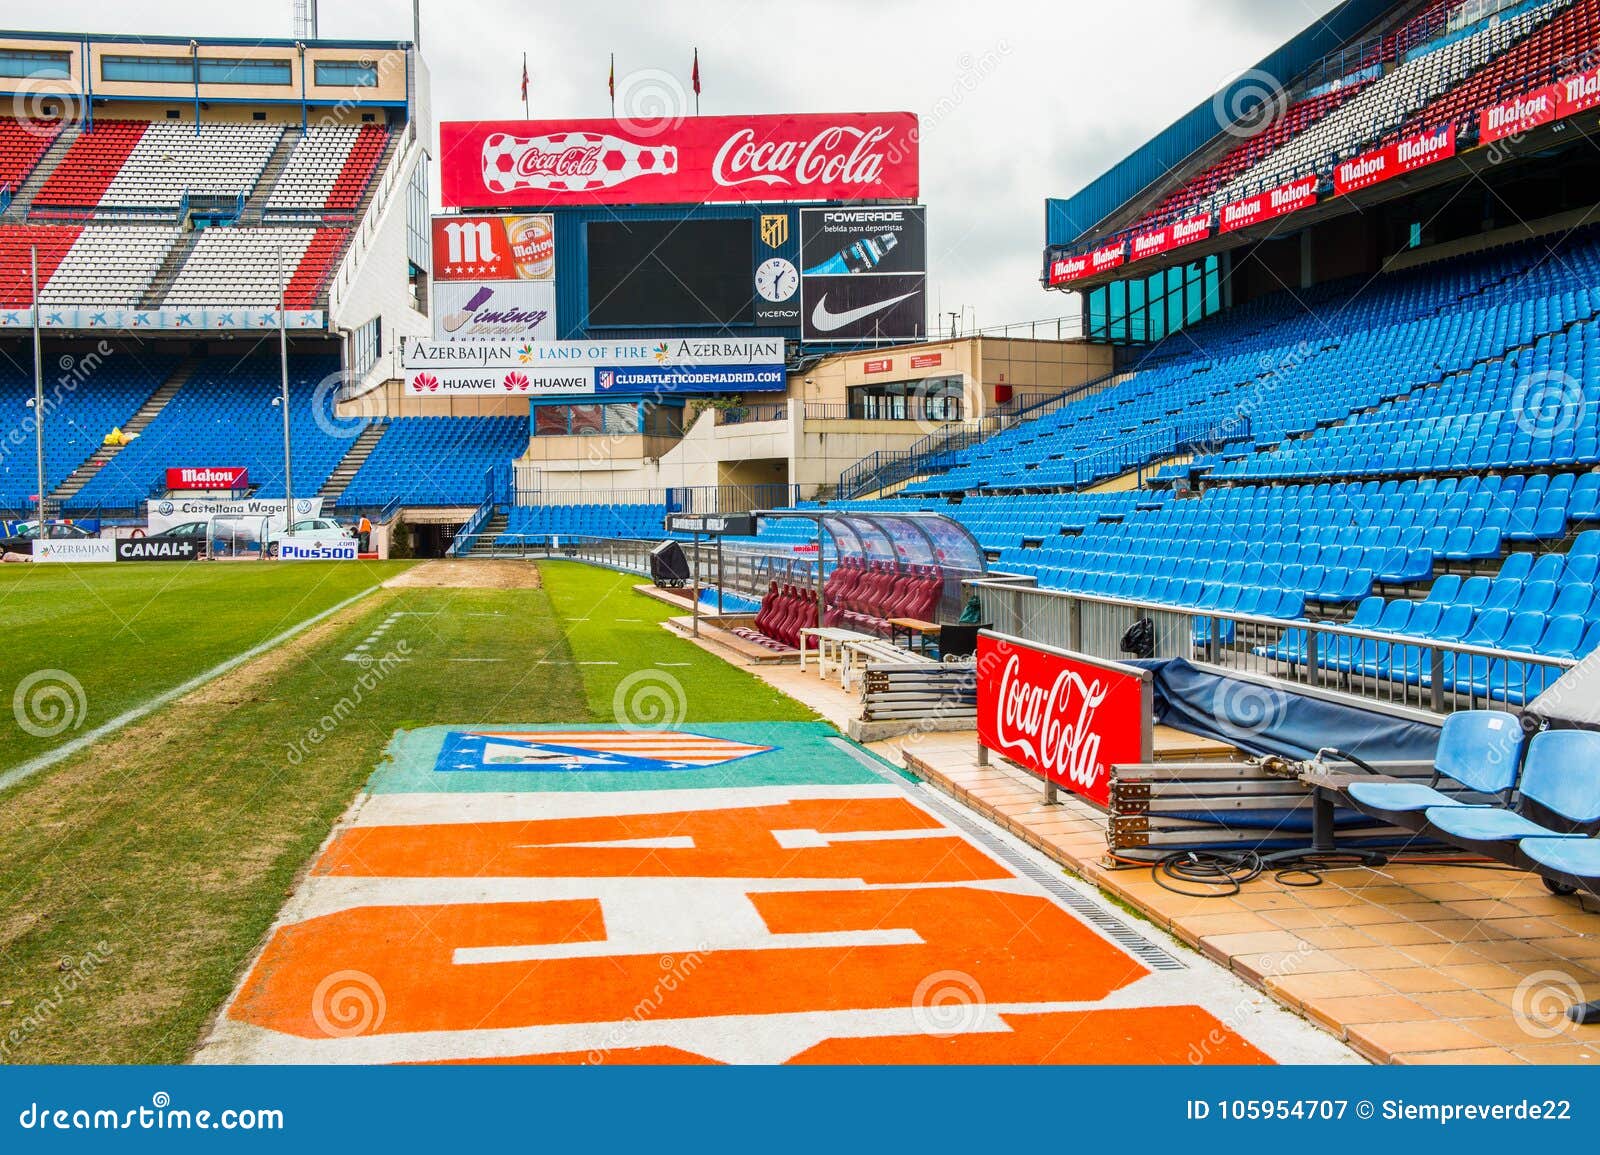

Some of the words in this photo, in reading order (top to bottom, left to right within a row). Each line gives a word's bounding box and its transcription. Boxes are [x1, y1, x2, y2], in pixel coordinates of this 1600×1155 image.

[1488, 94, 1547, 131] Mahou
[712, 126, 894, 186] Coca-Cola
[1398, 131, 1448, 163] Mahou
[517, 145, 602, 177] Coca-Cola
[1340, 155, 1385, 184] Mahou
[1271, 183, 1310, 207] Mahou
[824, 212, 903, 222] POWERADE
[1225, 198, 1261, 222] Mahou
[824, 225, 847, 233] bebida
[865, 225, 903, 233] deportistas
[1173, 220, 1205, 240] Mahou
[1135, 231, 1165, 251] Mahou
[1092, 246, 1120, 266] Mahou
[1054, 258, 1085, 276] Mahou
[757, 310, 799, 318] VICEROY
[539, 347, 582, 359] LAND
[588, 347, 607, 359] OF
[615, 346, 648, 358] FIRE
[443, 379, 496, 389] HUAWEI
[534, 378, 586, 388] HUAWEI
[616, 373, 781, 384] CLUBATLETICODEMADRID.COM
[181, 468, 234, 482] Mahou
[182, 502, 244, 514] Castellana
[120, 542, 193, 557] CANAL+
[282, 546, 354, 559] Plus500
[997, 654, 1109, 789] Coca-Cola
